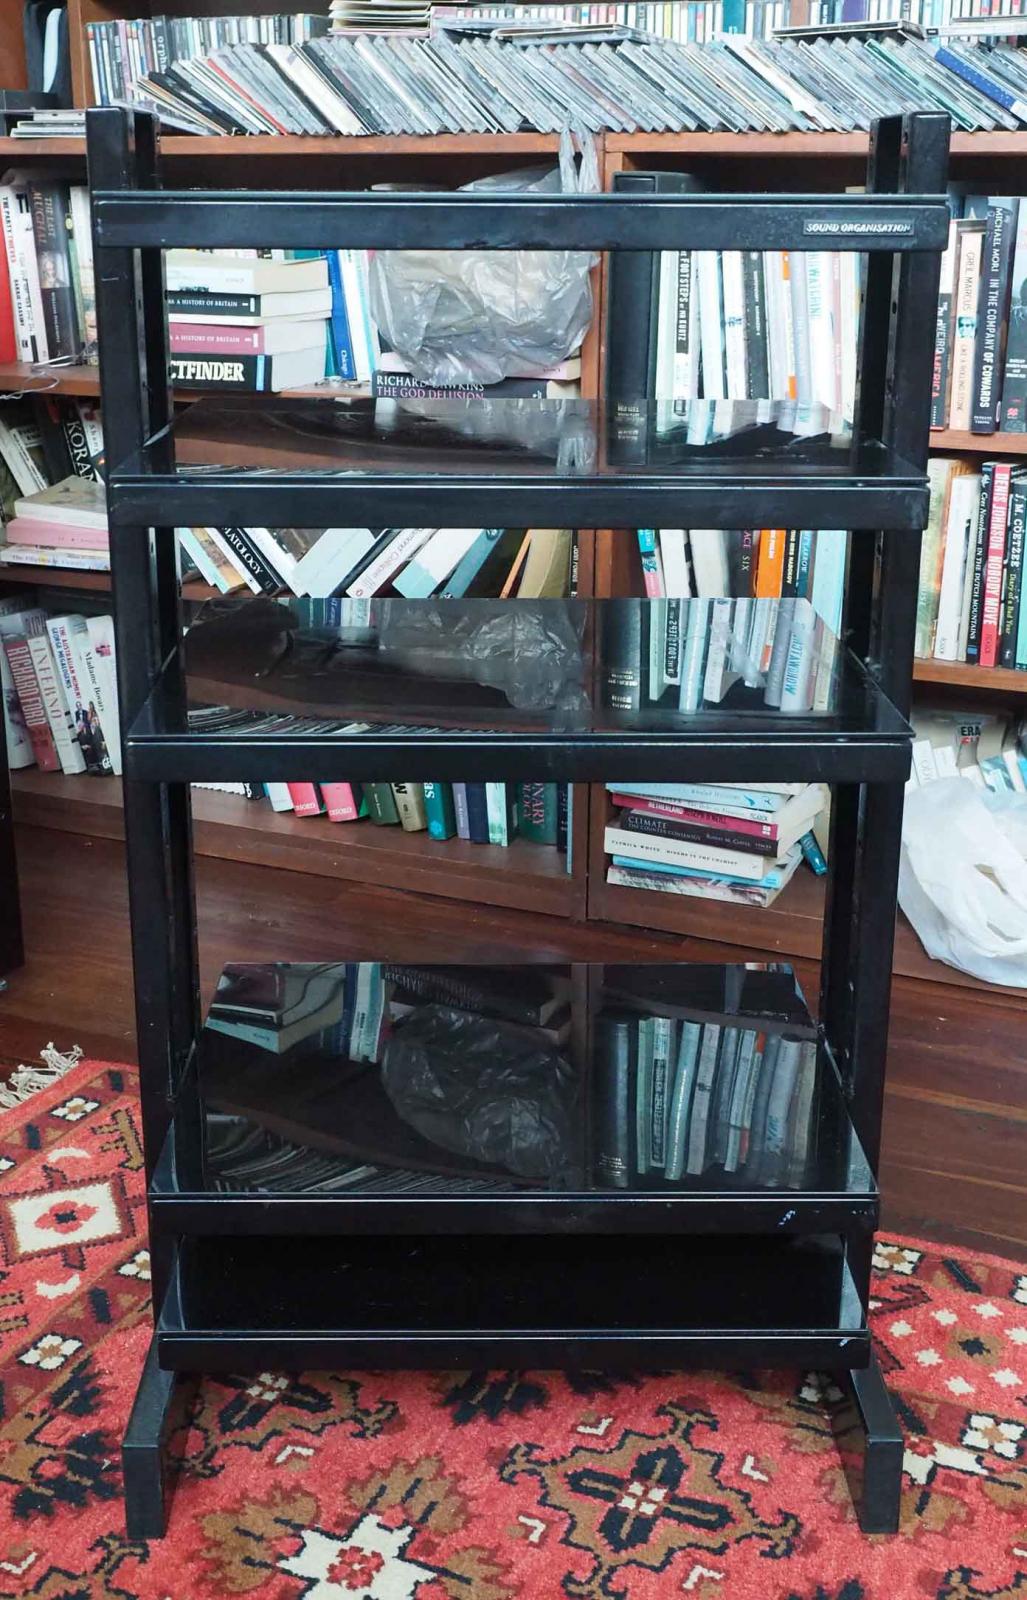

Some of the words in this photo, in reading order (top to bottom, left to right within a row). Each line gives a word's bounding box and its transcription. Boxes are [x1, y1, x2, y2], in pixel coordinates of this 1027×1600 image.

[806, 223, 839, 232] SOUND
[840, 223, 910, 233] ORGANISATION
[991, 208, 1004, 248] MICHAEL
[964, 252, 976, 276] GREIL
[990, 248, 1001, 272] MORI
[679, 258, 690, 302] FOOTSTEPS
[962, 276, 974, 311] MARCUS
[990, 278, 1000, 288] IN
[988, 290, 999, 306] THE
[678, 320, 686, 341] KURTZ
[936, 323, 946, 354] WEIRD
[984, 308, 998, 350] COMPANY
[984, 352, 994, 364] OF
[376, 386, 398, 396] THE
[400, 388, 426, 398] GOD
[428, 389, 485, 399] DELUSION
[980, 364, 993, 408] COWARDS
[992, 473, 1010, 502] DENIS
[1014, 504, 1024, 516] M.
[988, 504, 1007, 550] JOHNSON
[1010, 518, 1022, 568] COETZEE
[742, 555, 751, 572] SIX
[786, 556, 794, 584] NABOKOV
[986, 556, 1003, 597] NOBODY
[973, 573, 982, 597] DUTCH
[1007, 574, 1017, 590] Diary
[969, 599, 979, 640] MOUNTAINS
[983, 598, 1000, 625] MOVE
[52, 628, 62, 649] GEORGE
[58, 626, 67, 638] THE
[1004, 620, 1012, 635] Year
[56, 650, 72, 689] MEGALOGENIS
[62, 638, 76, 674] AUSTRALIAN
[7, 646, 39, 696] RICHARD
[33, 648, 62, 719] INFERNO
[84, 652, 98, 685] Madame
[94, 687, 105, 713] Bovary
[70, 676, 82, 699] MOMENT
[21, 696, 46, 726] FORD
[628, 817, 668, 830] CLIMATE
